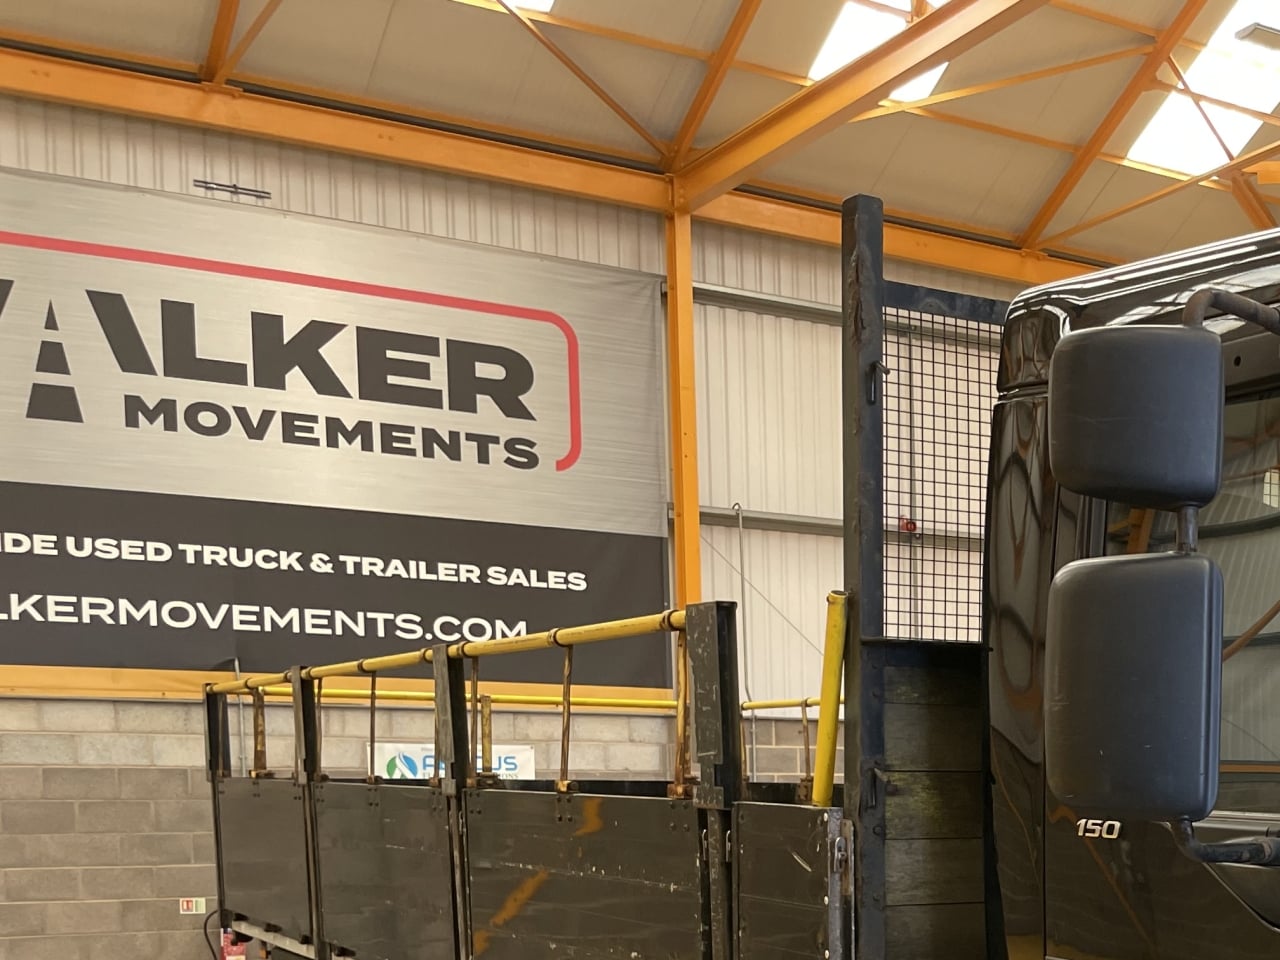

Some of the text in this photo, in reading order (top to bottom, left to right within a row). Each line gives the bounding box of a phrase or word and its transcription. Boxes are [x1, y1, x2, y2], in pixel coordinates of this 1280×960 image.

[124, 394, 540, 470] MOVEMENTS
[0, 532, 588, 592] DE USED TRUCK & TRAILER SALES
[1076, 818, 1121, 839] 150
